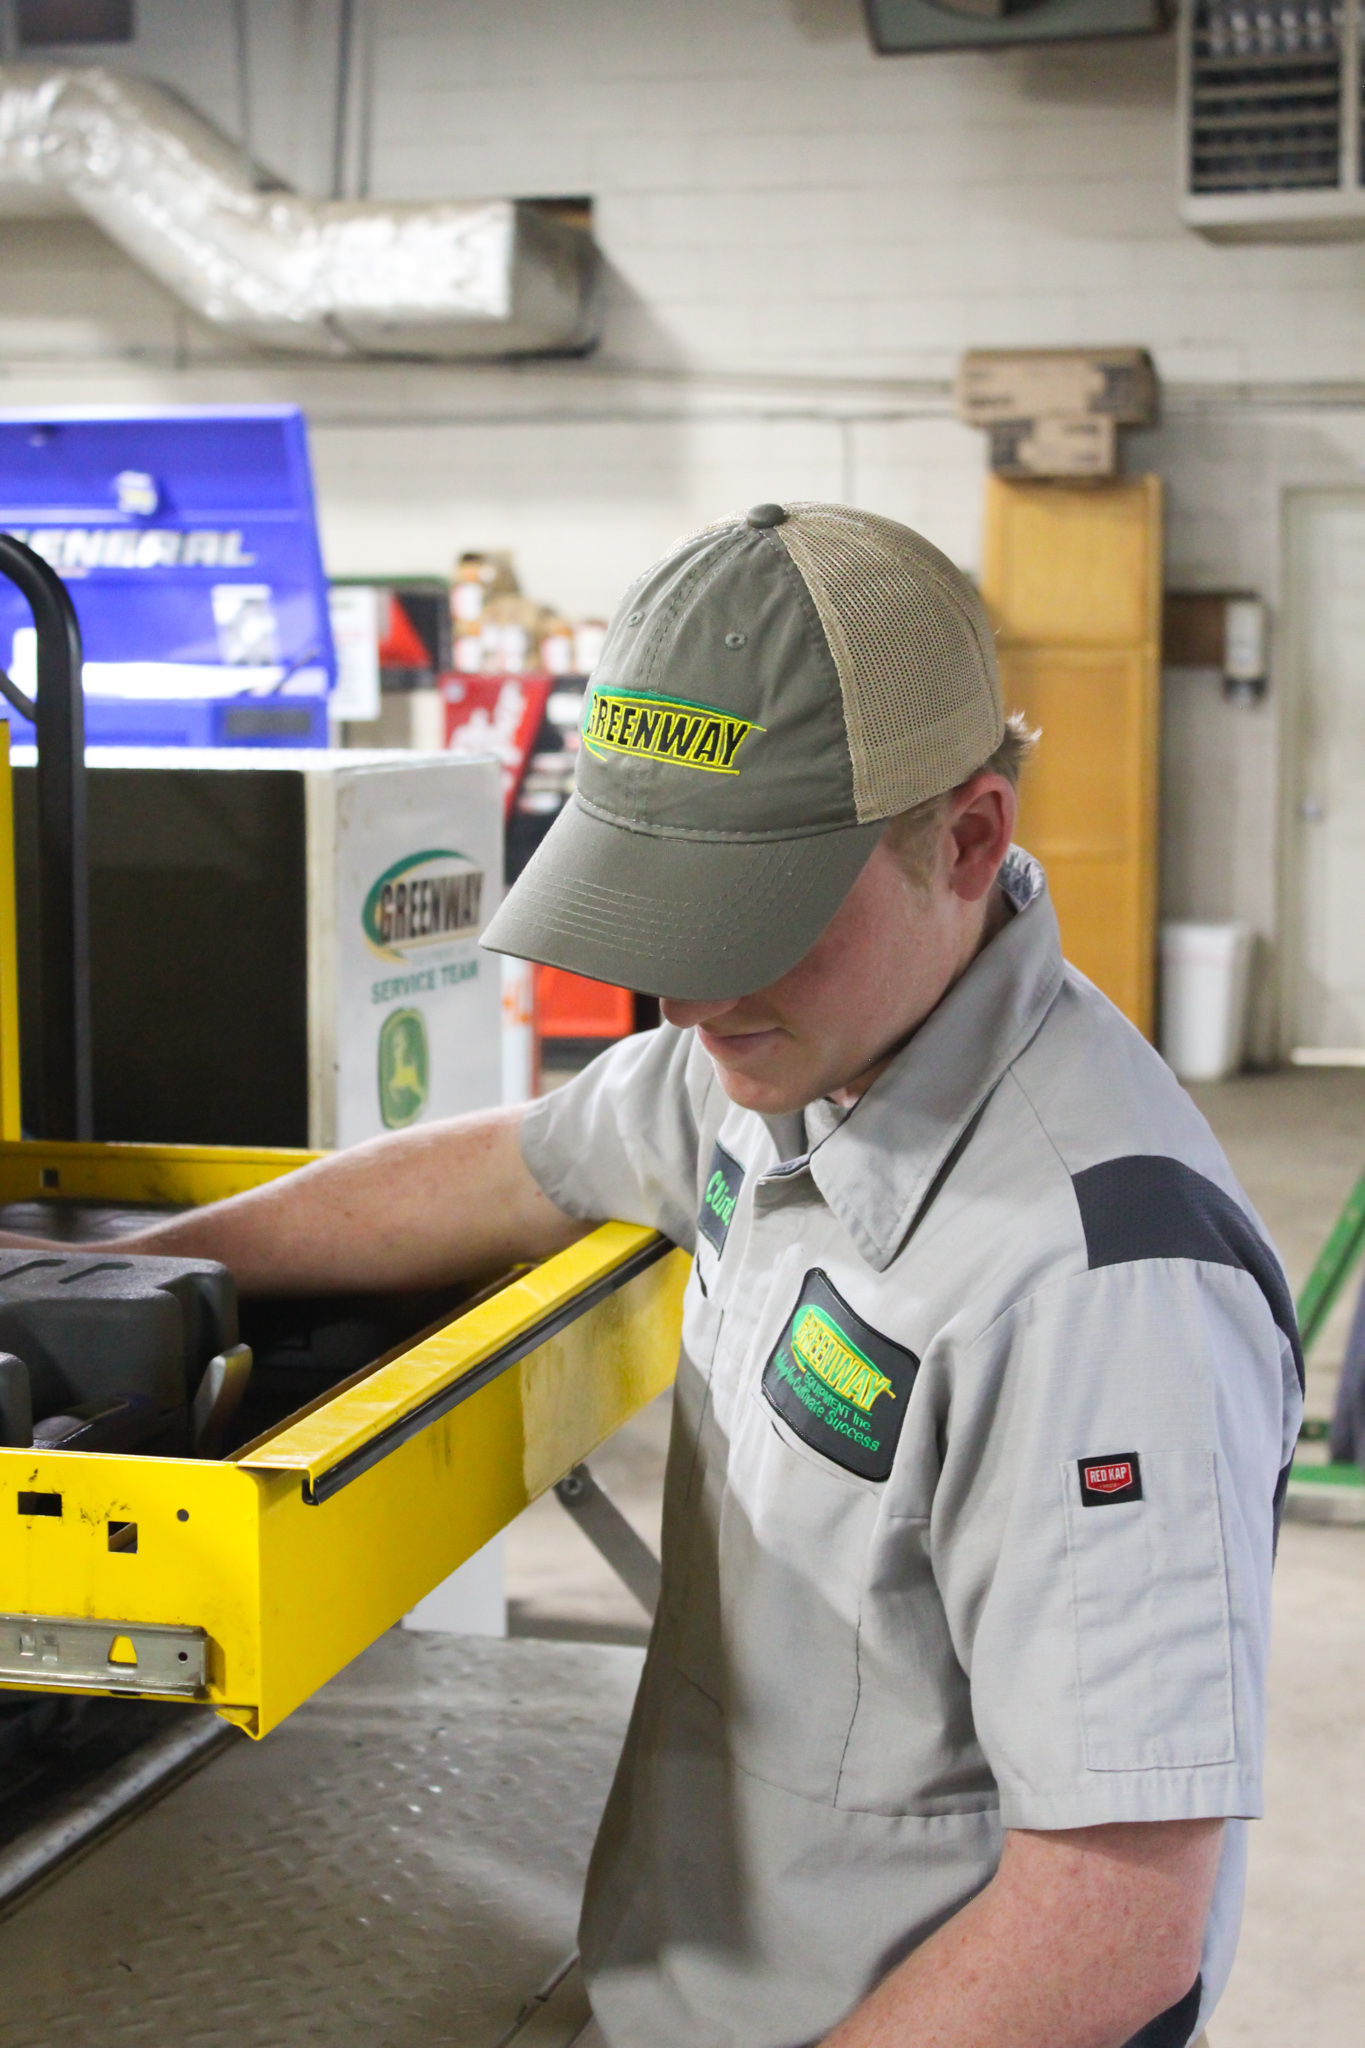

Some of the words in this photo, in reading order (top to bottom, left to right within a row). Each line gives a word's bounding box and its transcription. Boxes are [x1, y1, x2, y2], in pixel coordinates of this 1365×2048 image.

[379, 871, 484, 945] GREENWAY
[371, 968, 436, 1005] SERVICE
[441, 959, 479, 987] TEAM
[793, 1309, 892, 1411] GREENWAY
[803, 1370, 852, 1419] EQUIPMENT
[824, 1410, 880, 1452] Success
[1090, 1469, 1107, 1483] RED
[1108, 1466, 1127, 1480] KAP
